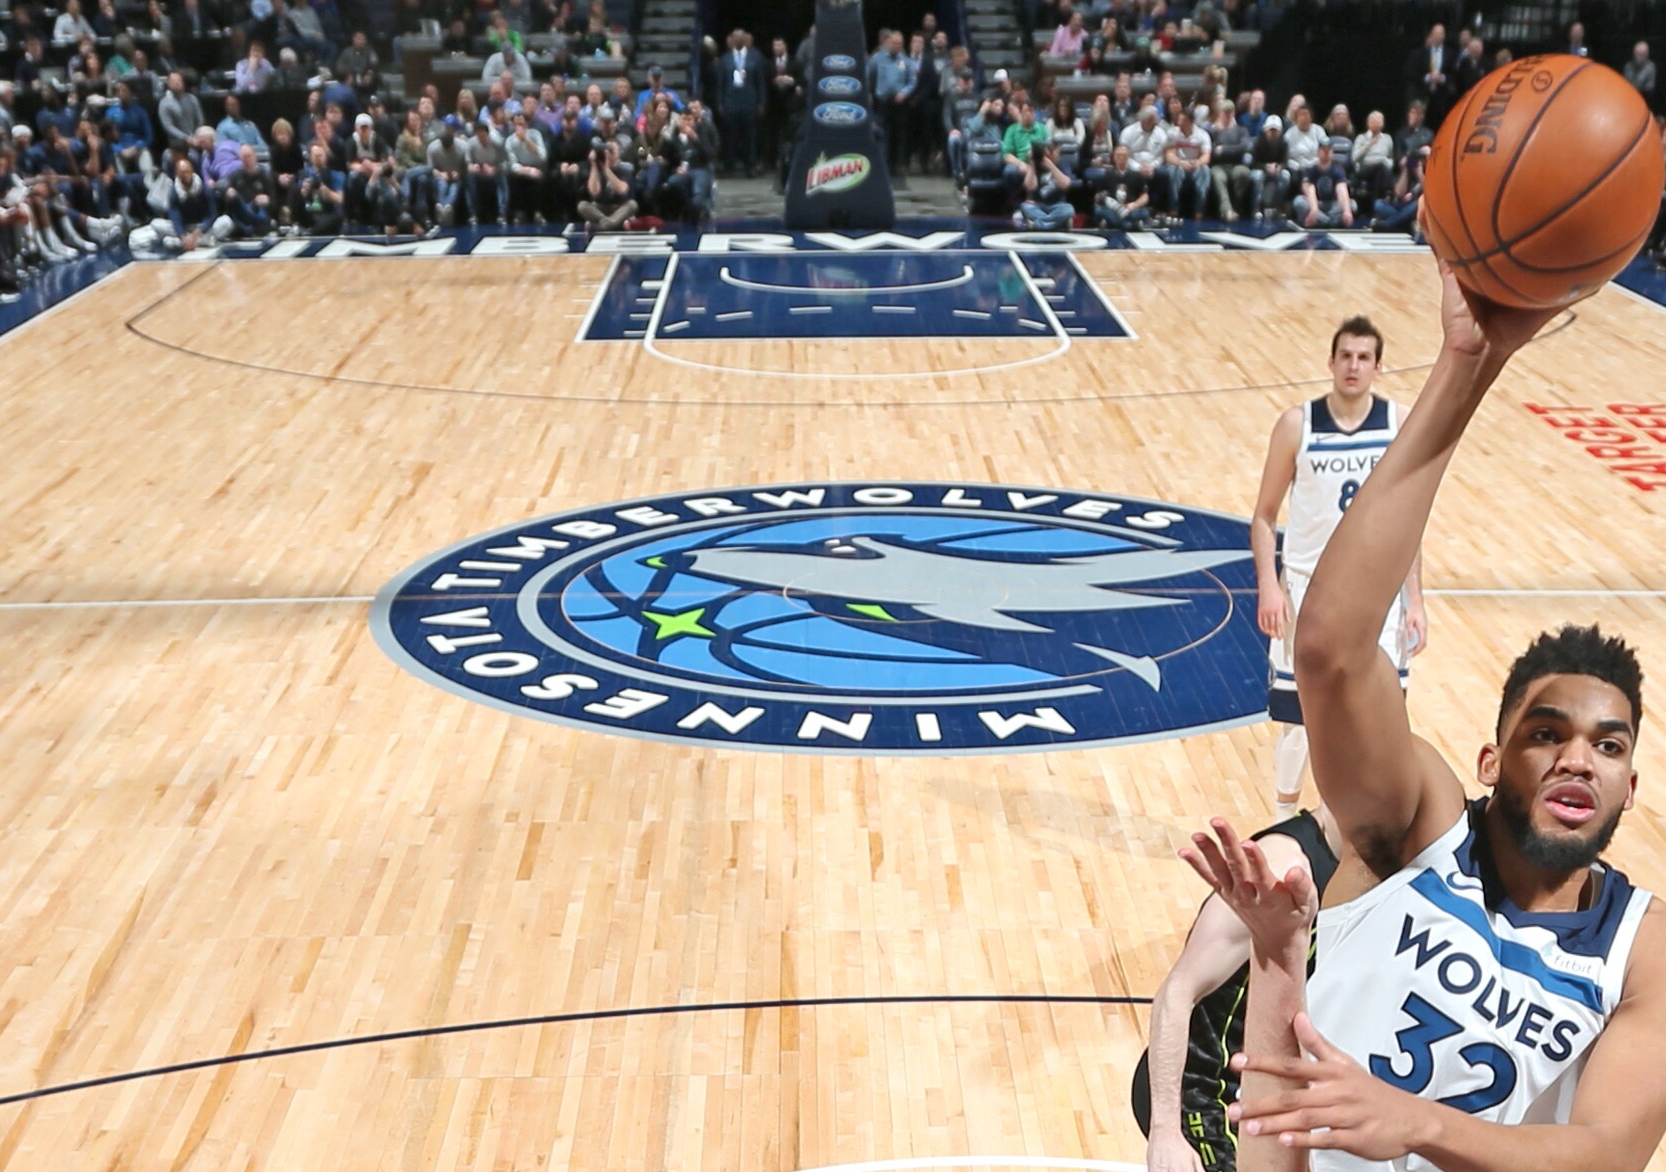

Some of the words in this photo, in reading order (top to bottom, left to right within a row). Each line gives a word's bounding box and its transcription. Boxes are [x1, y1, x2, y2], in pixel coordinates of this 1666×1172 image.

[1464, 56, 1544, 154] LDING
[806, 158, 864, 189] LIBMAN
[179, 232, 1431, 261] TIMBERWOLVE
[1310, 454, 1380, 474] WOLVE
[434, 487, 1185, 592] TIMBERWOLVES
[419, 604, 1077, 742] MINNESOTA
[1394, 912, 1582, 1062] WOLVES
[1553, 955, 1593, 975] fitbit
[1369, 990, 1518, 1115] 32
